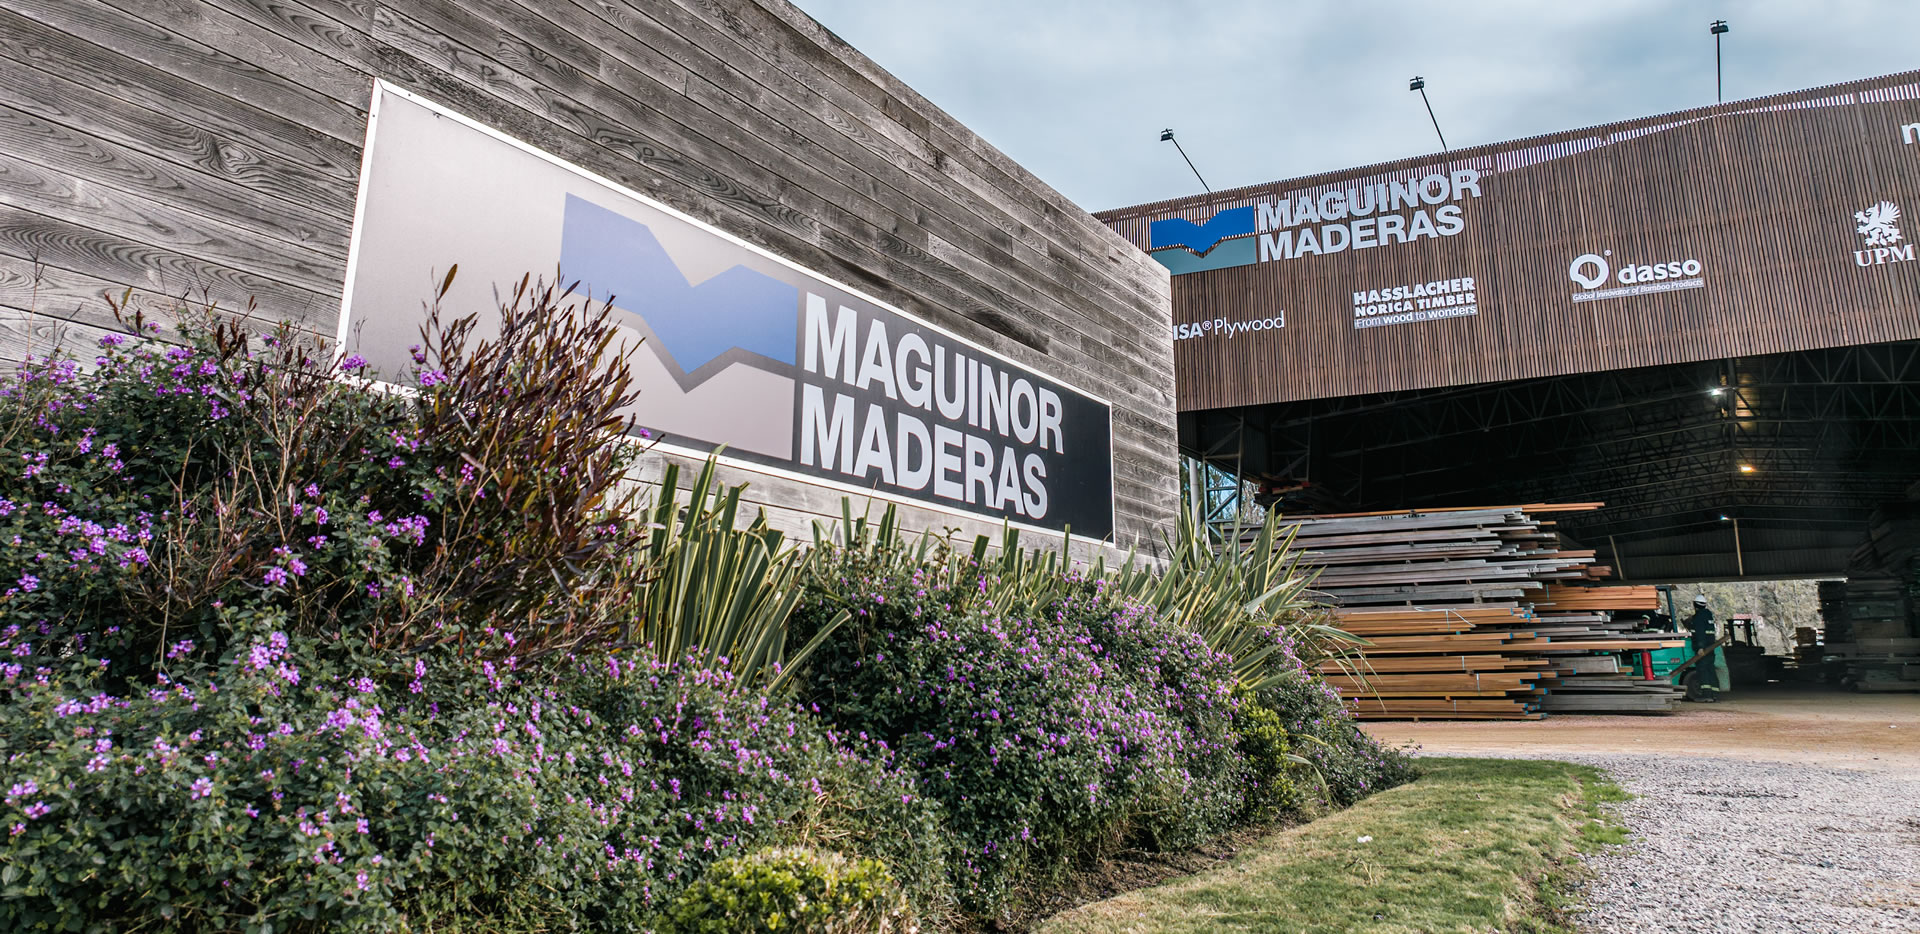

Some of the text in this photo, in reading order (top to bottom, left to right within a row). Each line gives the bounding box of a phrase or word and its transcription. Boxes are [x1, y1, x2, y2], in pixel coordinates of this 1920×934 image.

[1258, 169, 1482, 231] MAGUINOR
[1259, 205, 1465, 262] MADERAS
[1853, 244, 1917, 267] UPM
[1618, 259, 1701, 284] dasso
[1353, 277, 1476, 305] HASSLACHER
[1573, 278, 1703, 301] Global Innovator of Bamboo Products
[1355, 293, 1476, 317] NORICA TIMBER
[1356, 305, 1477, 327] From wood to wonders
[1214, 310, 1285, 339] Plywood
[803, 291, 1064, 454] MAGUINOR
[800, 382, 1048, 519] MADERAS
